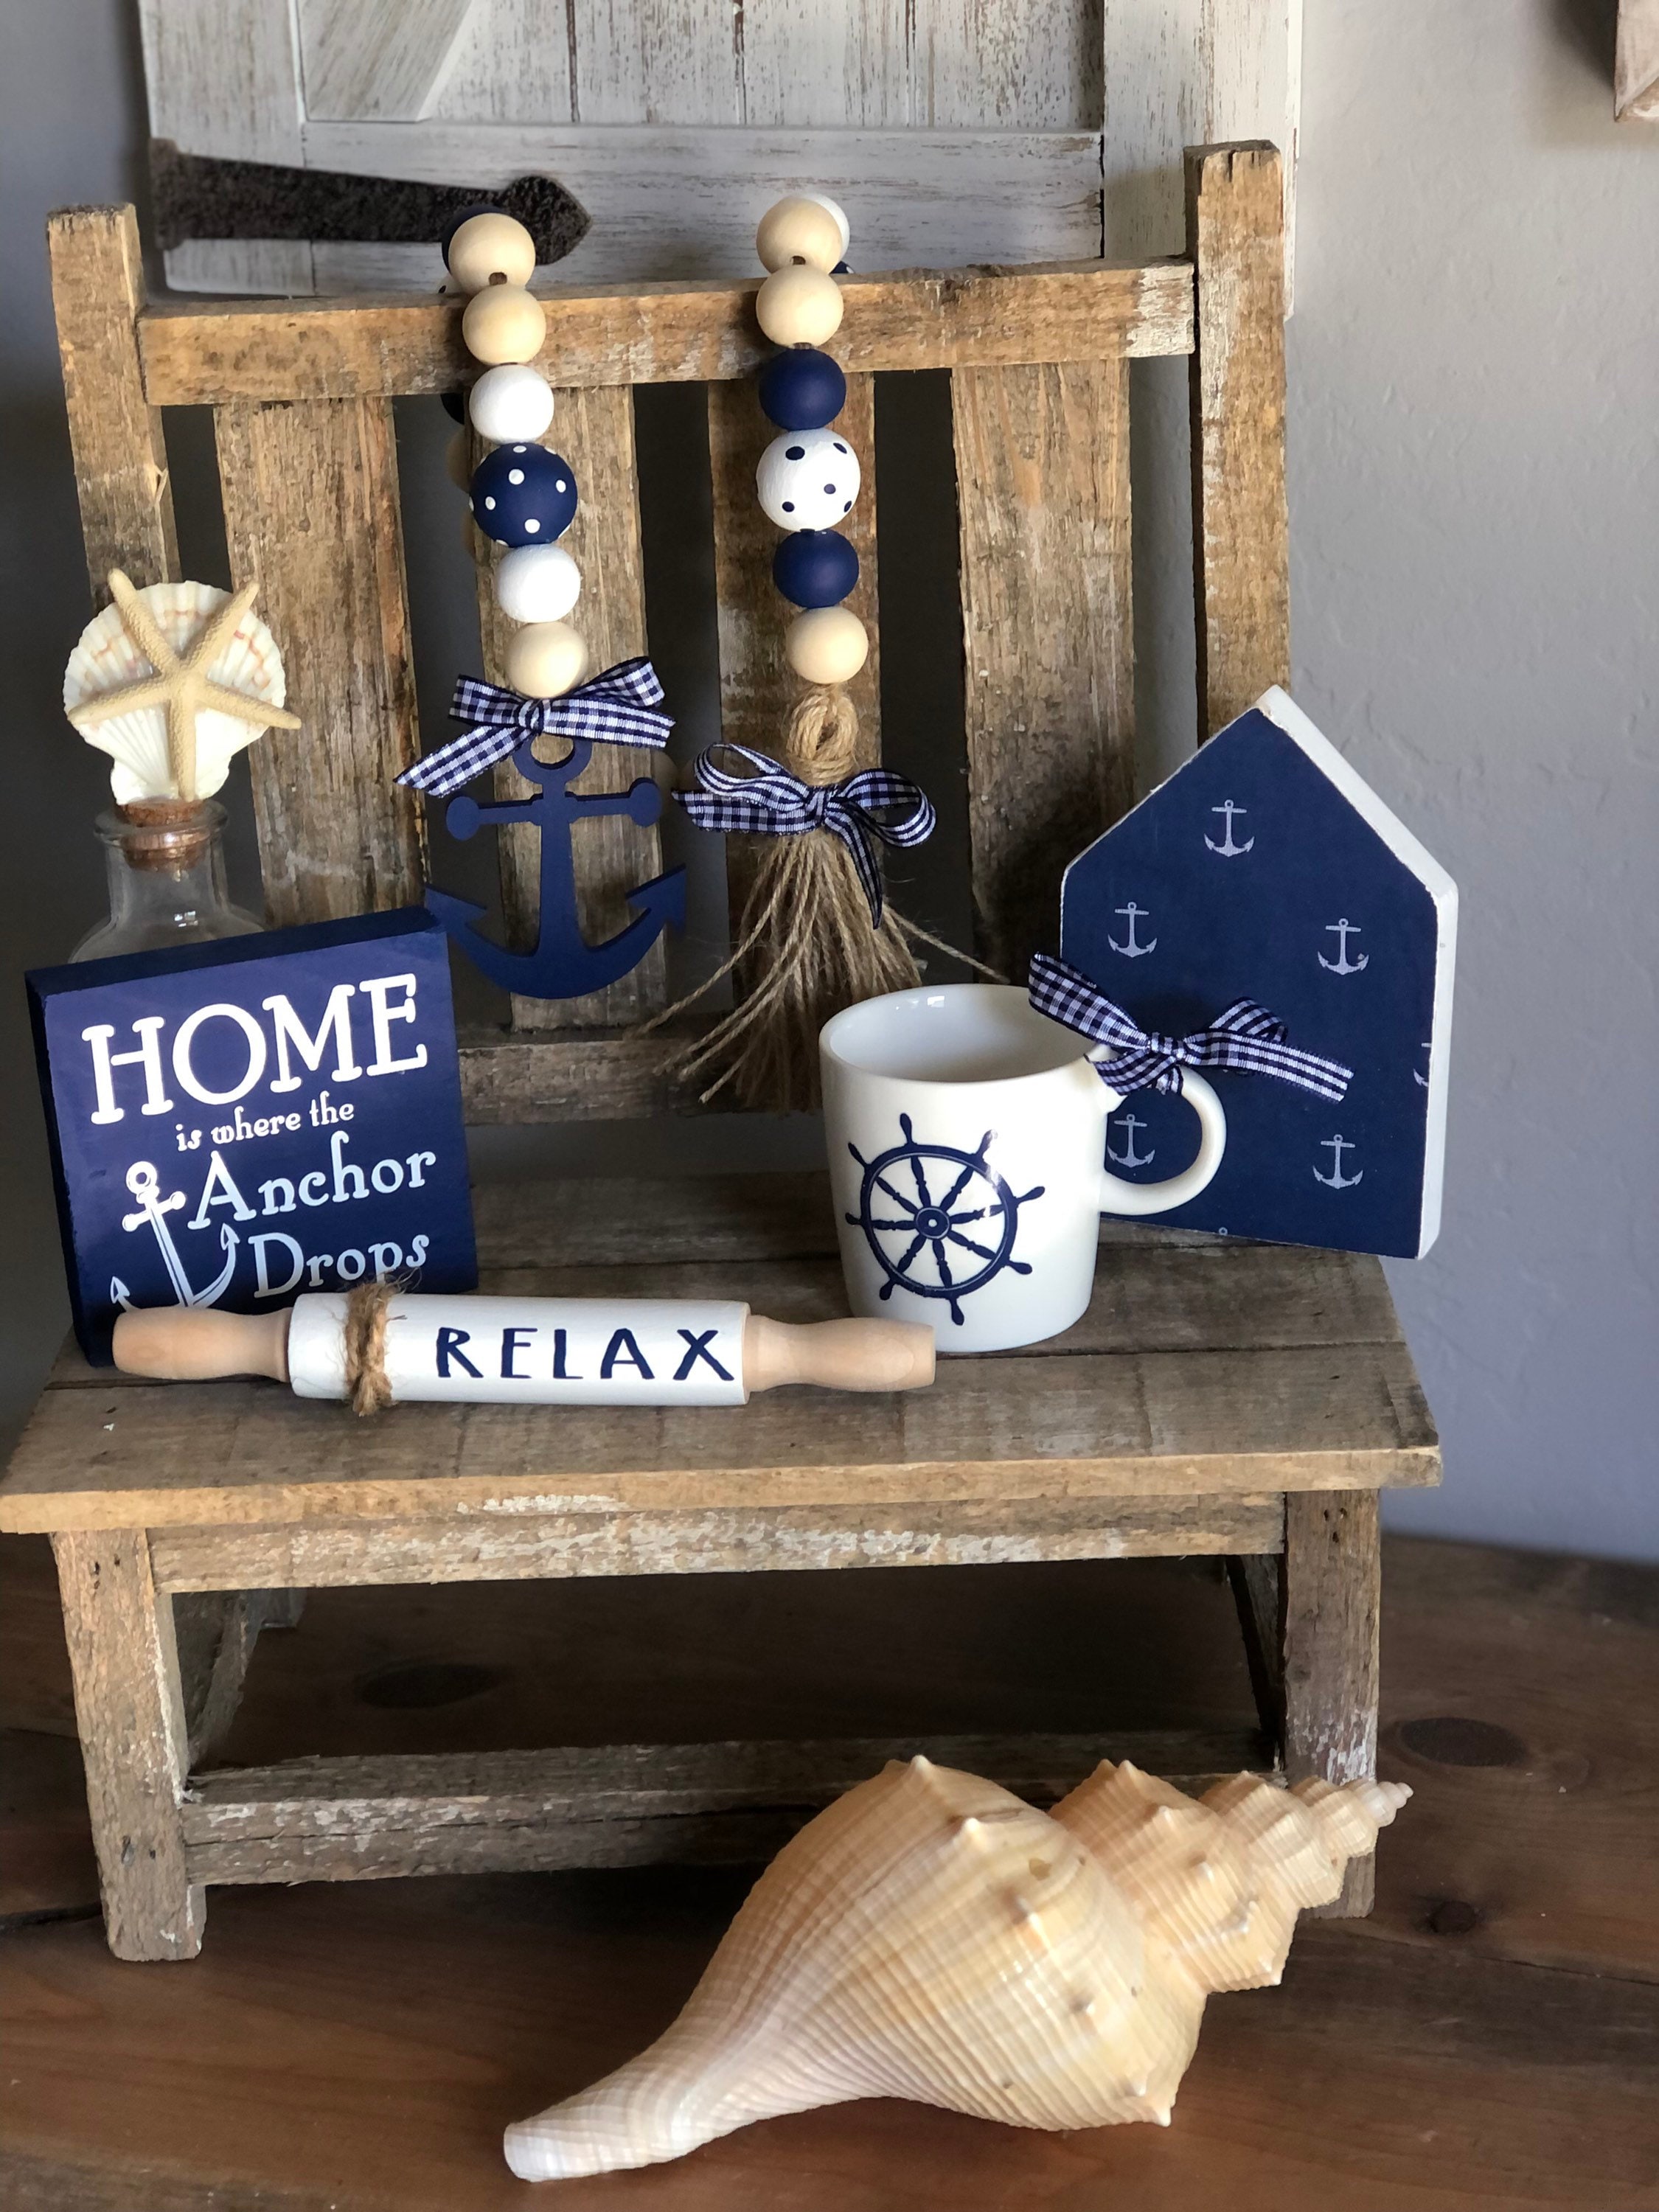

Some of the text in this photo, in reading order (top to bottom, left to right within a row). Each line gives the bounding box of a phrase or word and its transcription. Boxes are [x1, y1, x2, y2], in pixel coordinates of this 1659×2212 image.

[81, 973, 428, 1124] HOME
[176, 1091, 355, 1152] is where the
[187, 1130, 437, 1230] Anchor
[247, 1233, 430, 1299] Drops
[437, 1326, 735, 1382] RELAX
